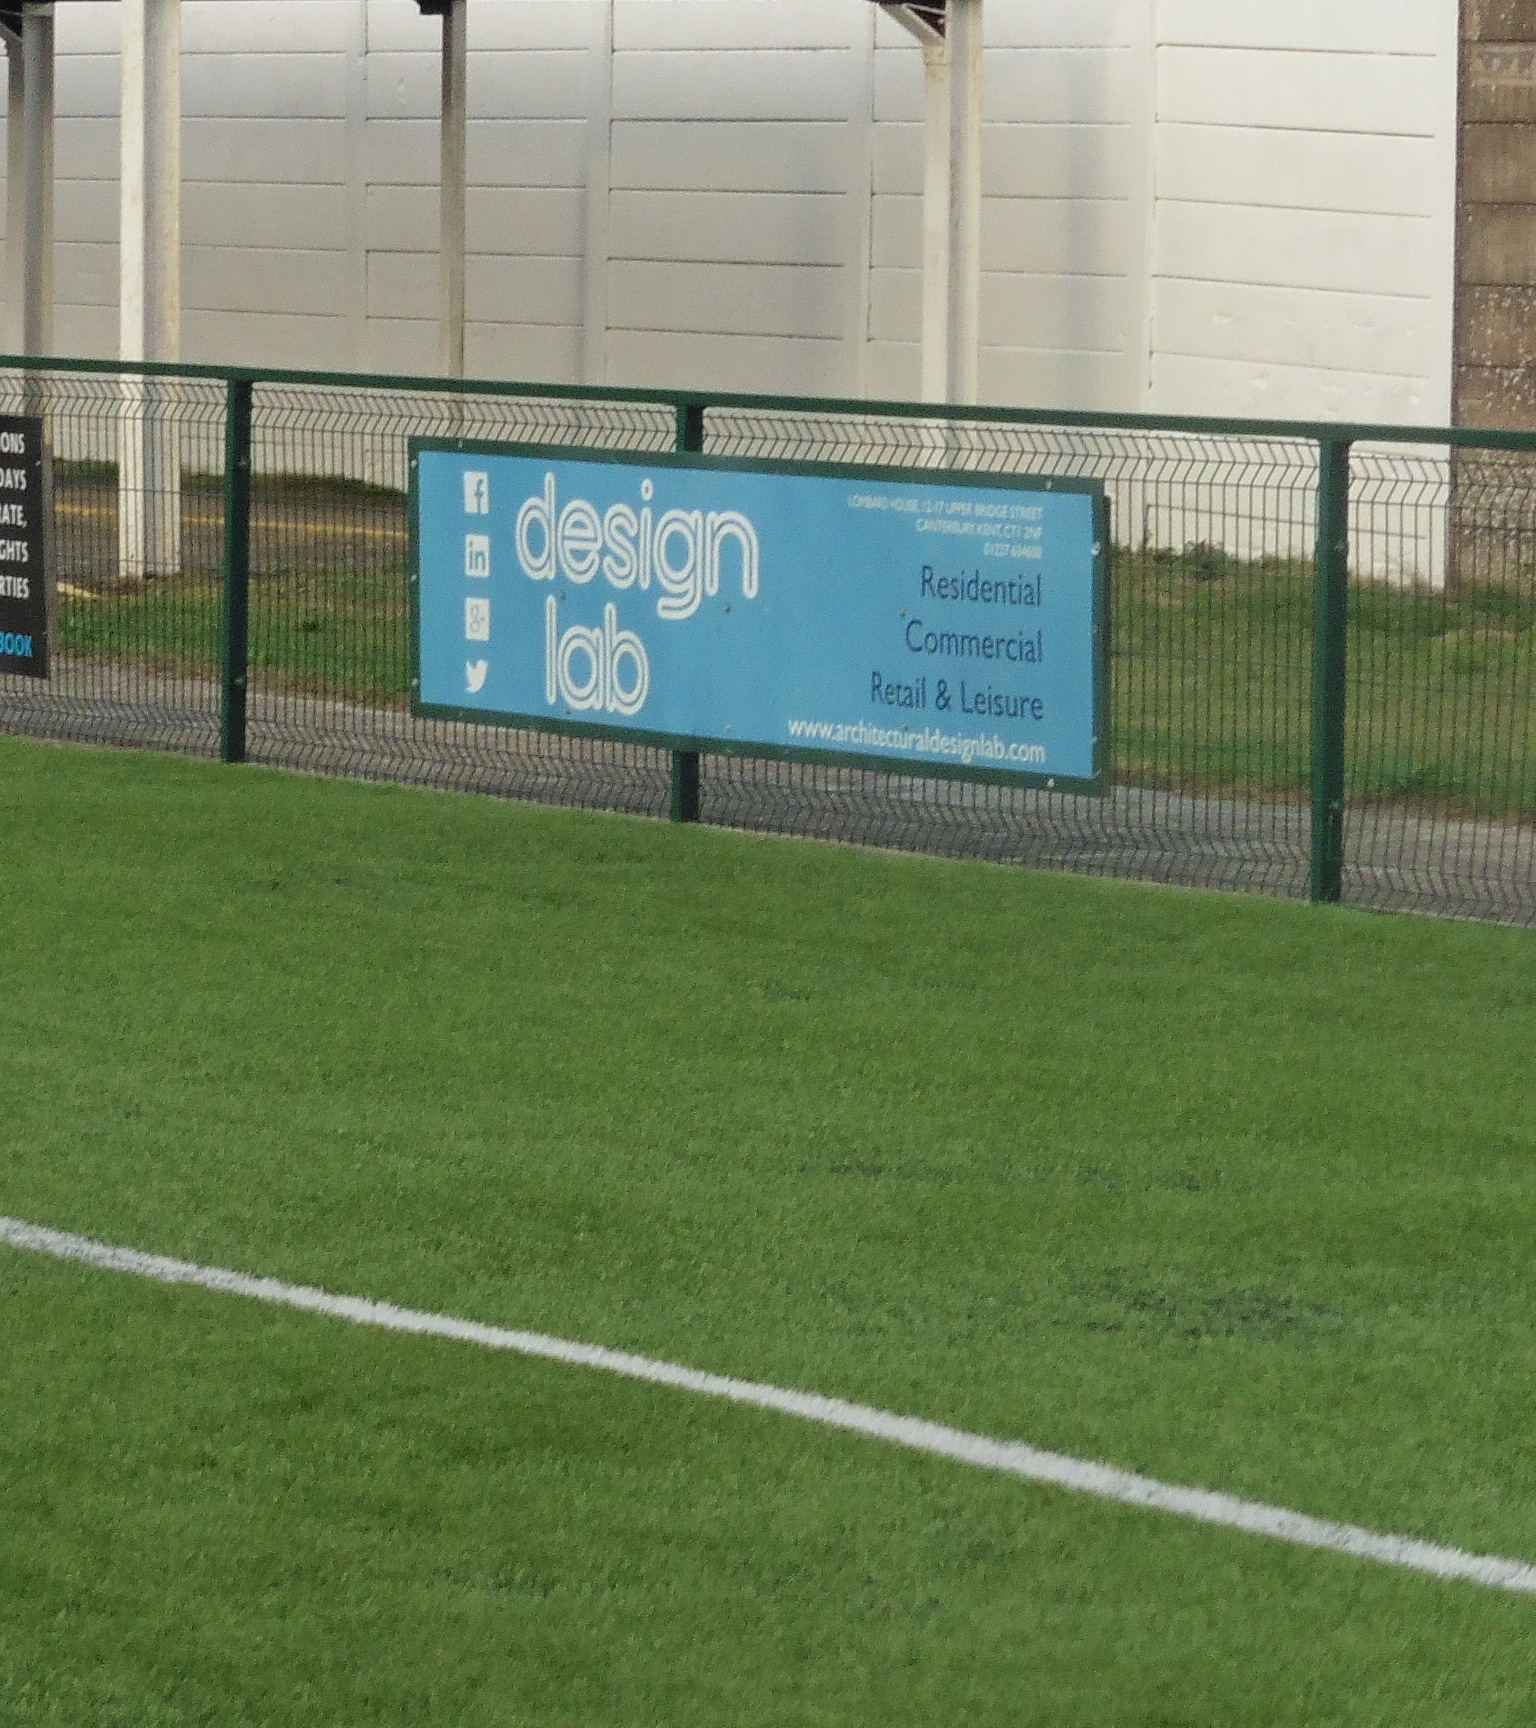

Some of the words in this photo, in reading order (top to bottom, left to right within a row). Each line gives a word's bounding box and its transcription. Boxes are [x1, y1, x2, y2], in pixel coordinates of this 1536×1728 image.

[515, 472, 758, 620] design
[921, 566, 1042, 606] Residential
[545, 595, 650, 716] lab
[905, 620, 1042, 663] Commercial
[871, 672, 926, 709] Retail
[934, 681, 952, 711] &
[960, 680, 1043, 720] Leisure
[788, 716, 1045, 763] www.architecturaldesignlab.com
